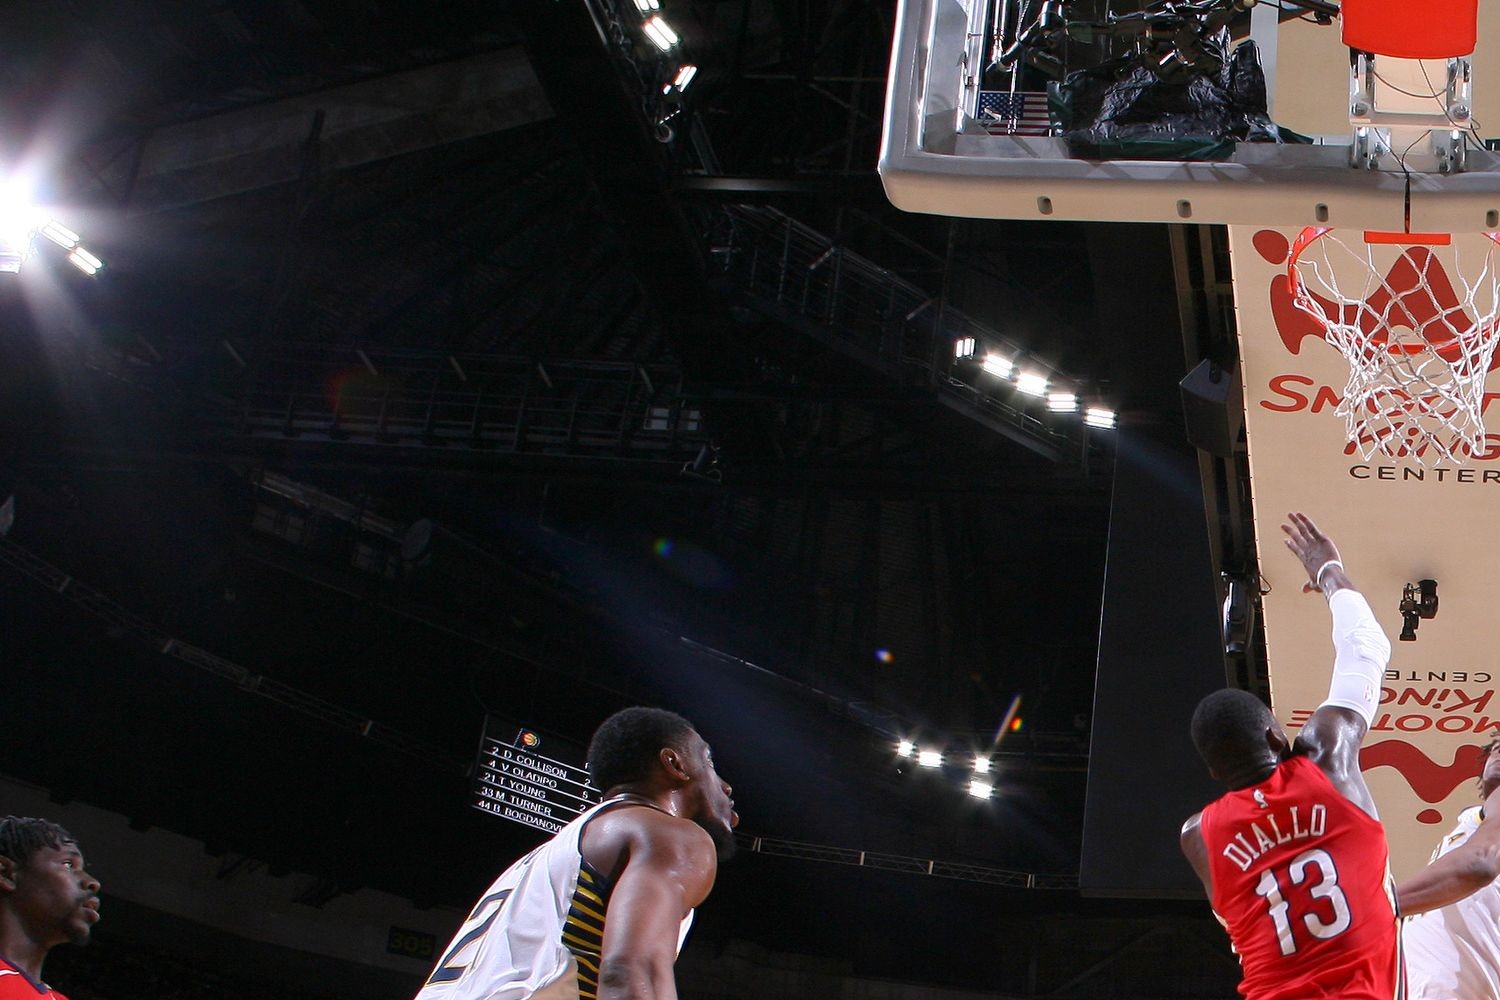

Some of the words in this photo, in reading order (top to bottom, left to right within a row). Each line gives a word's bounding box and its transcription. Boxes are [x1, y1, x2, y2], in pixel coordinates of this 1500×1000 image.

[1384, 670, 1493, 684] CENTE
[512, 767, 558, 789] OLADIPO
[517, 755, 567, 779] COLLISON
[509, 780, 547, 799] YOUNG
[510, 795, 552, 816] TURNER
[1223, 803, 1327, 872] DIALLO
[1256, 849, 1351, 956] 13
